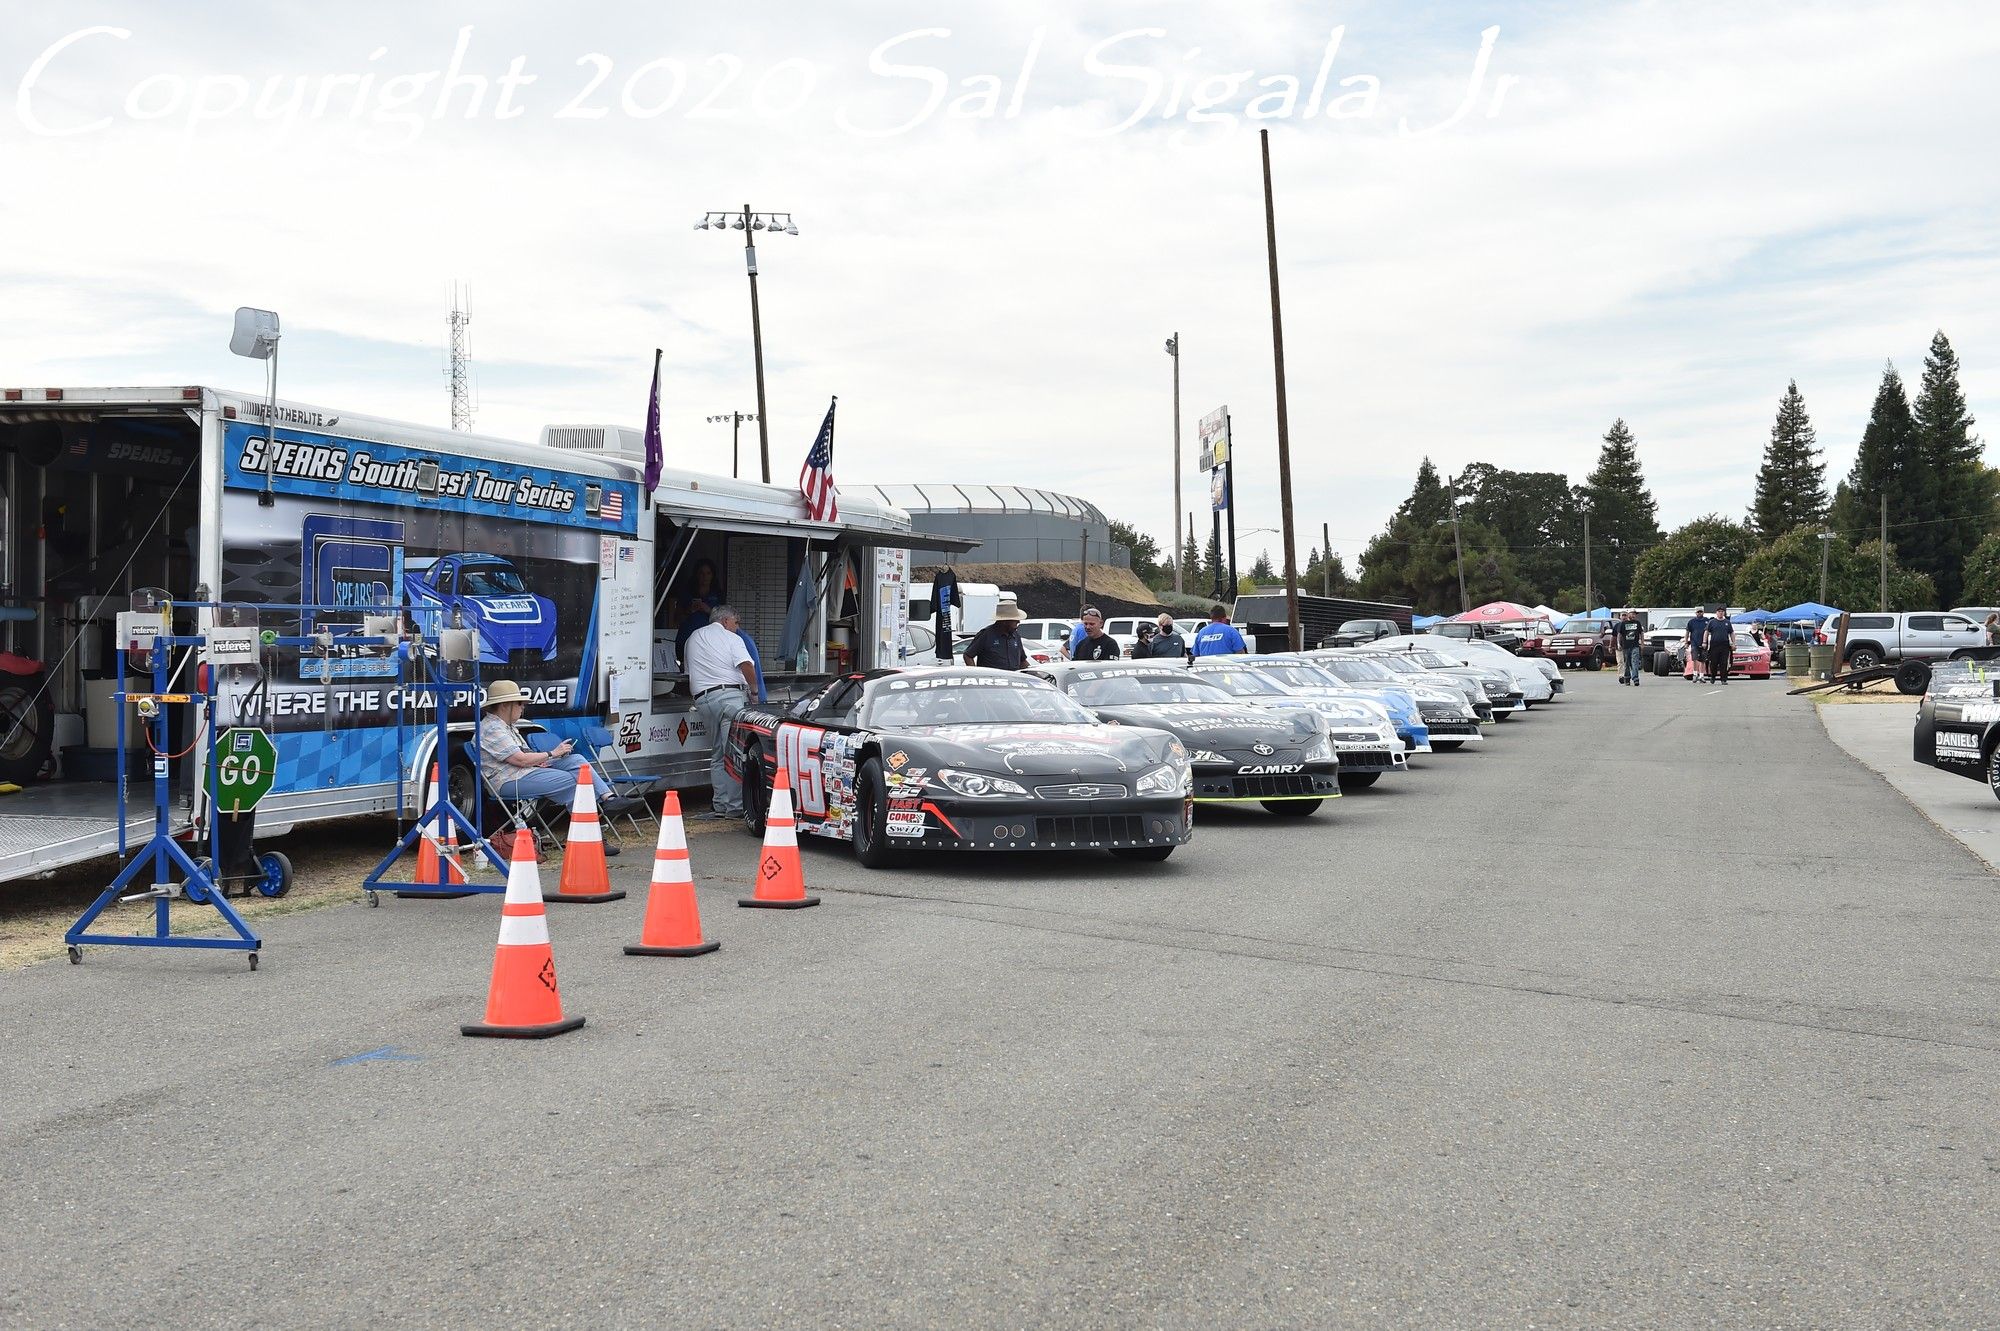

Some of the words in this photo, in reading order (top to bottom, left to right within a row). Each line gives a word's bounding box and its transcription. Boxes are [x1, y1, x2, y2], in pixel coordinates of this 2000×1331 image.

[240, 437, 347, 482] SPEARS
[349, 452, 471, 498] Southest
[474, 471, 516, 502] Tour
[516, 477, 575, 511] Series
[336, 582, 372, 611] SPEARS
[214, 641, 251, 651] referee
[1102, 668, 1173, 678] SPEARS
[914, 677, 1009, 690] SPEARS
[231, 692, 326, 717] WHERE
[334, 690, 381, 712] THE
[620, 712, 642, 736] 51
[1936, 731, 1979, 748] DANIELS
[220, 755, 261, 785] GO
[1238, 764, 1304, 775] CAMRY
[889, 813, 915, 821] COMP
